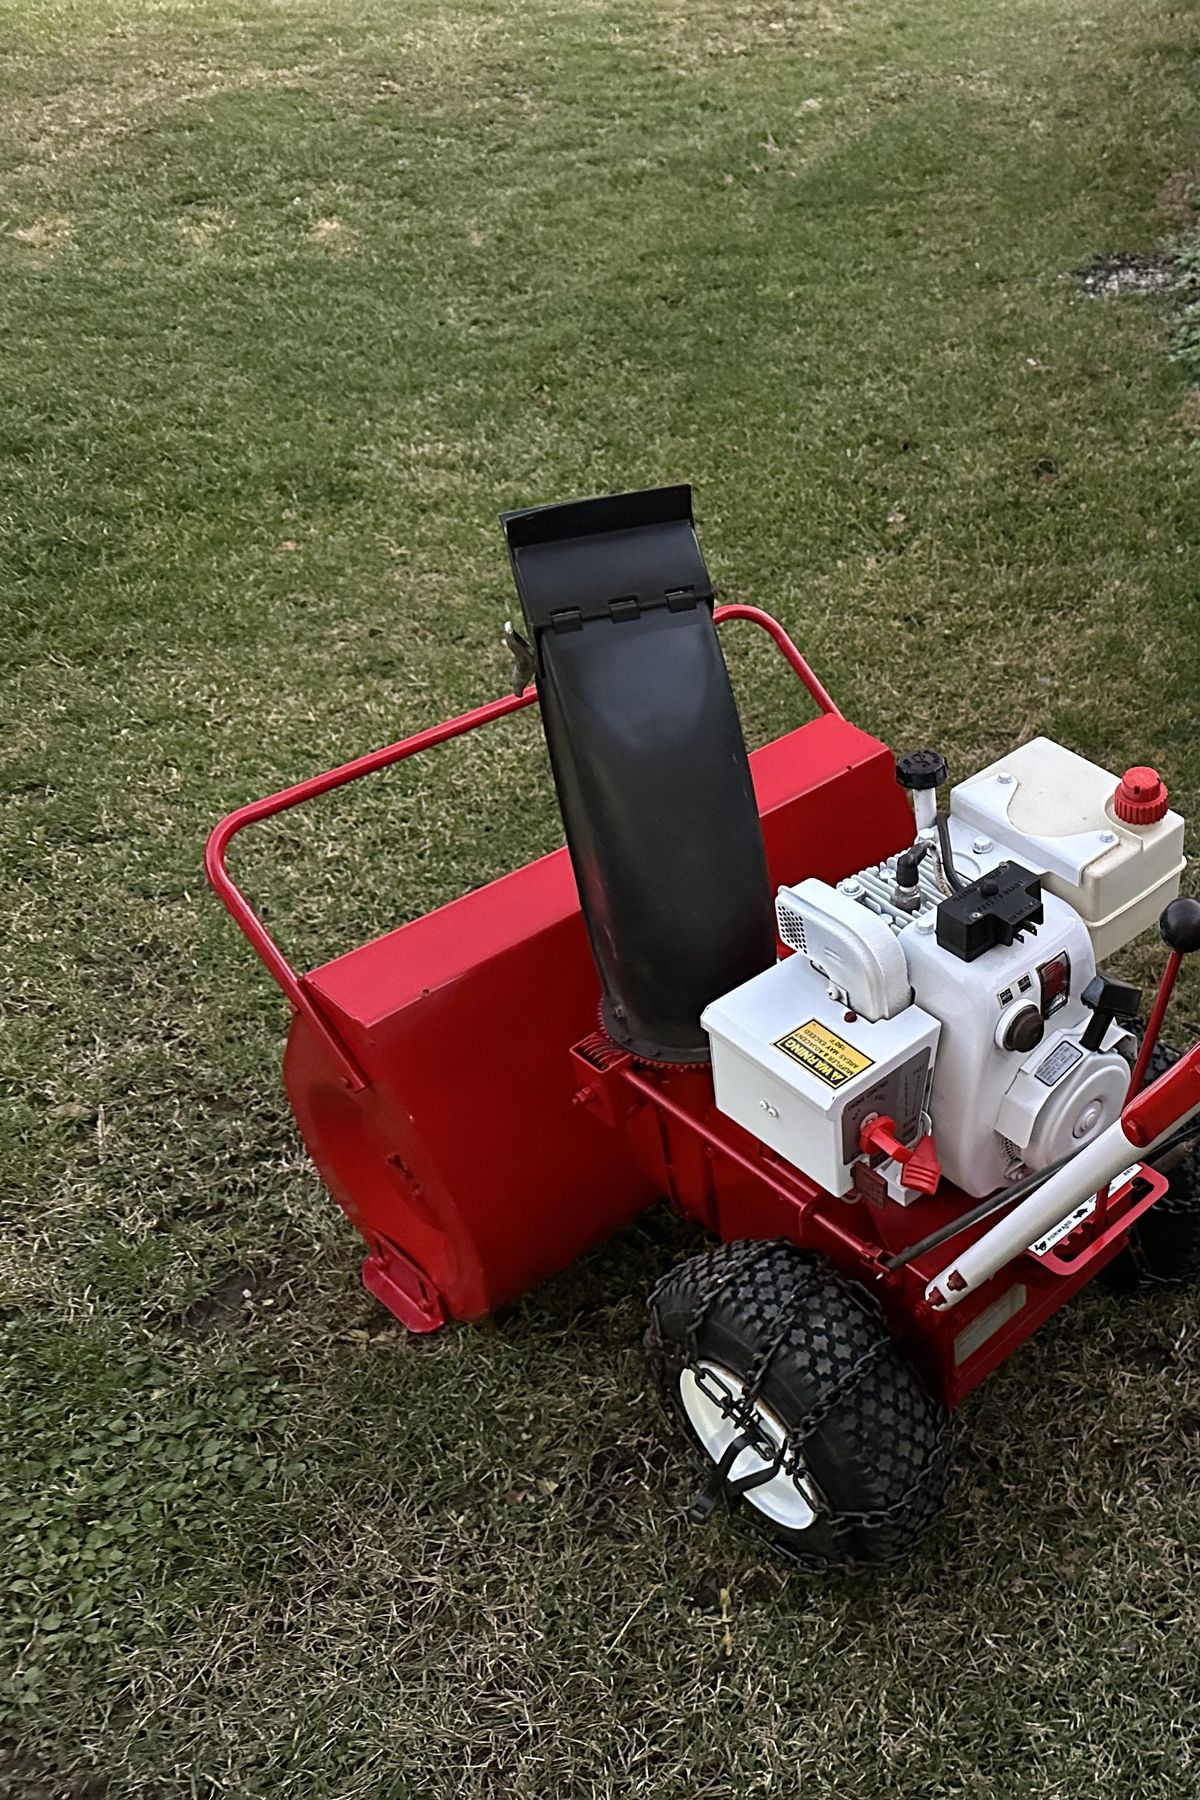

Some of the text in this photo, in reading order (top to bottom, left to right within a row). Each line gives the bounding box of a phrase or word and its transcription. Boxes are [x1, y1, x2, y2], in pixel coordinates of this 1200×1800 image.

[793, 1031, 824, 1054] ADJACENT
[802, 1028, 859, 1069] AREAS MAY EXCEED
[781, 1037, 836, 1076] WARNING
[826, 1055, 854, 1075] MUFFLER
[1047, 1219, 1073, 1241] FORWARD
